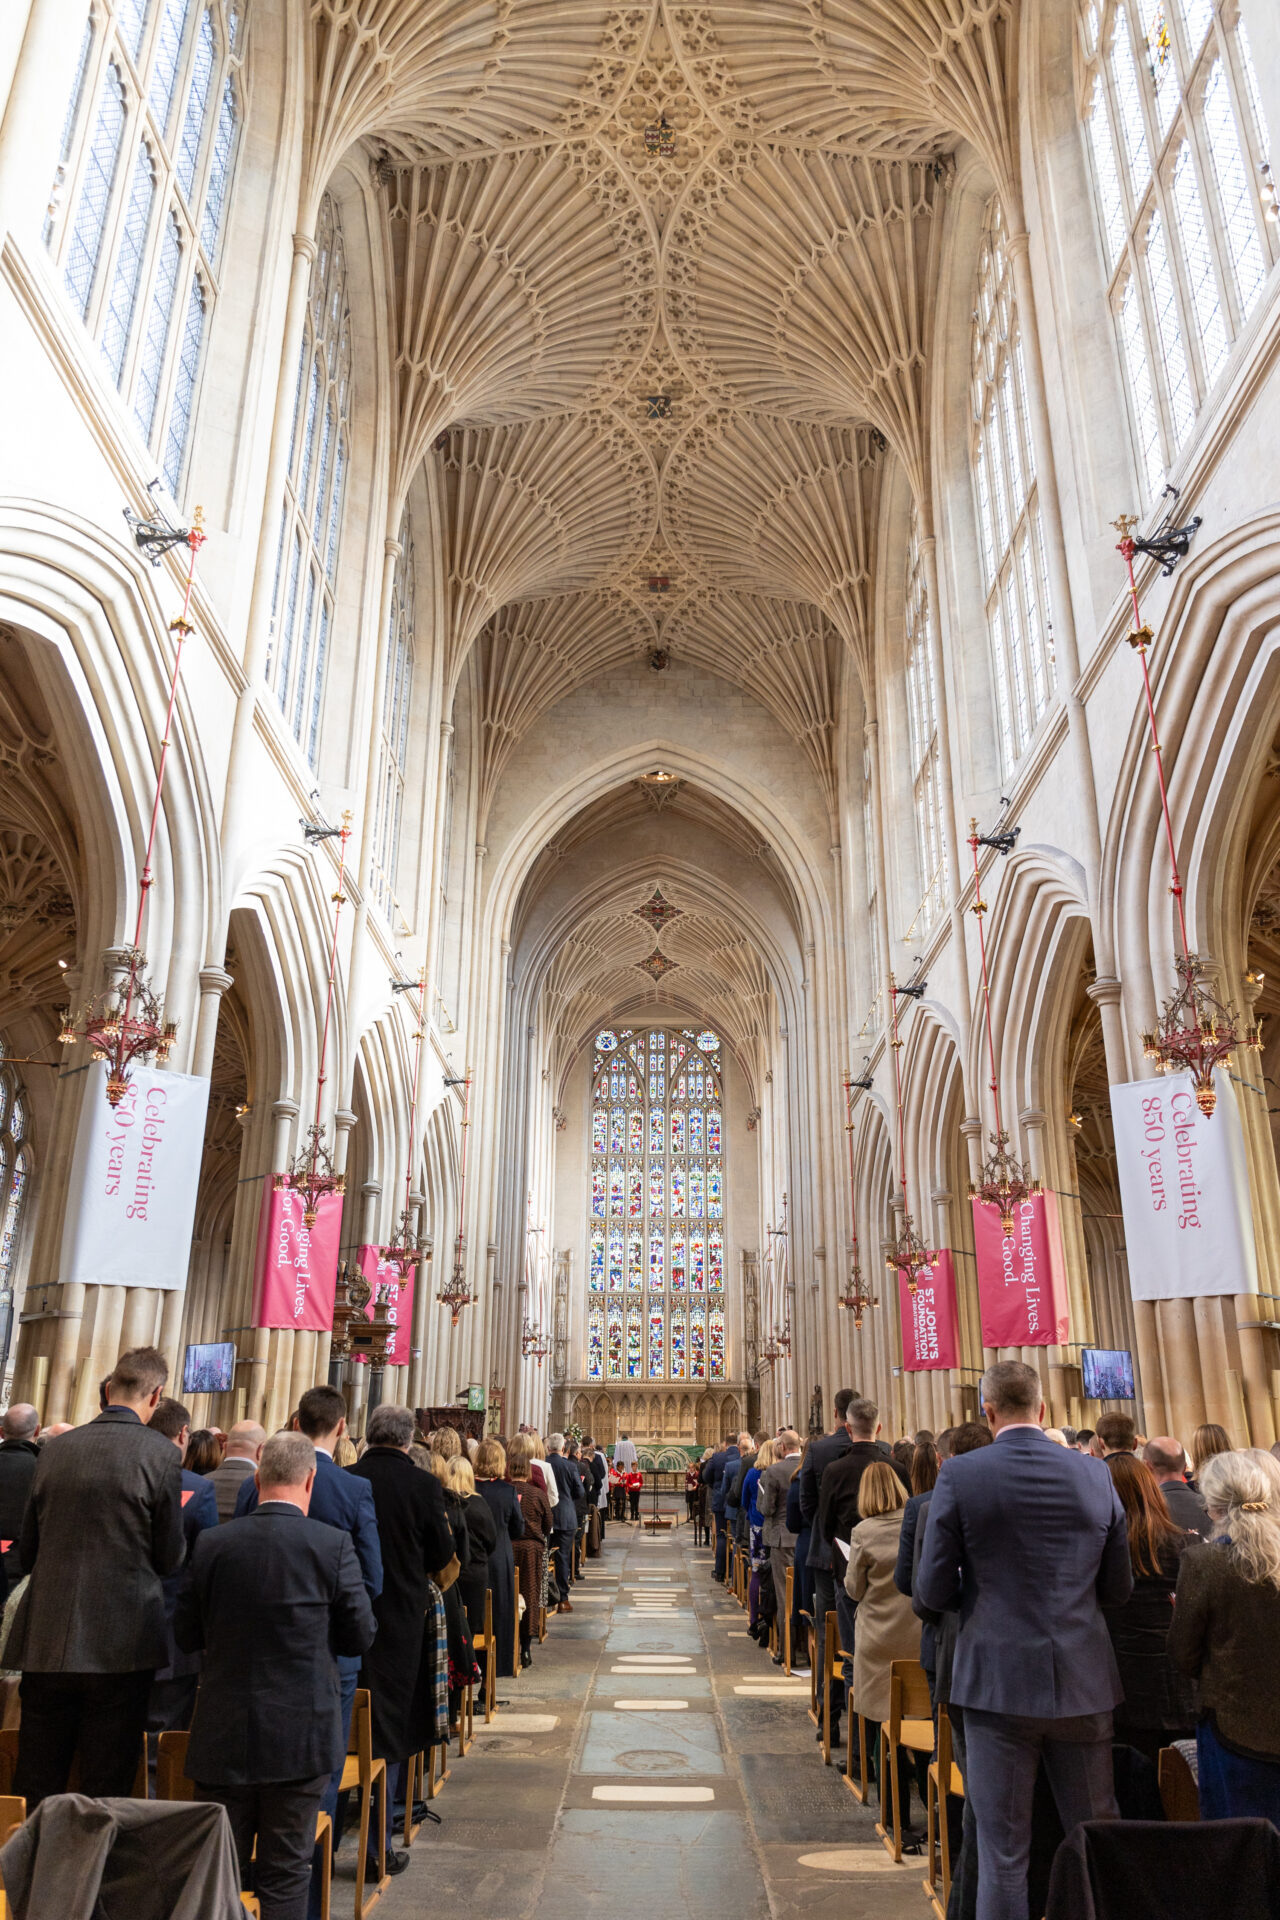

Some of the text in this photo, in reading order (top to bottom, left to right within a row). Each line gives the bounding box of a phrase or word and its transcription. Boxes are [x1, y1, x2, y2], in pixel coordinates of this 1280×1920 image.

[105, 1131, 127, 1196] years
[126, 1087, 167, 1221] Celebrating
[1141, 1096, 1167, 1211] 850 years
[1170, 1092, 1202, 1229] Celebrating
[277, 1218, 295, 1268] Good.
[1002, 1237, 1019, 1287] Good.
[1018, 1202, 1041, 1334] Changing Lives.
[294, 1272, 311, 1318] Lives.
[917, 1289, 929, 1360] FOUNDATION
[926, 1307, 939, 1359] JOHN'S
